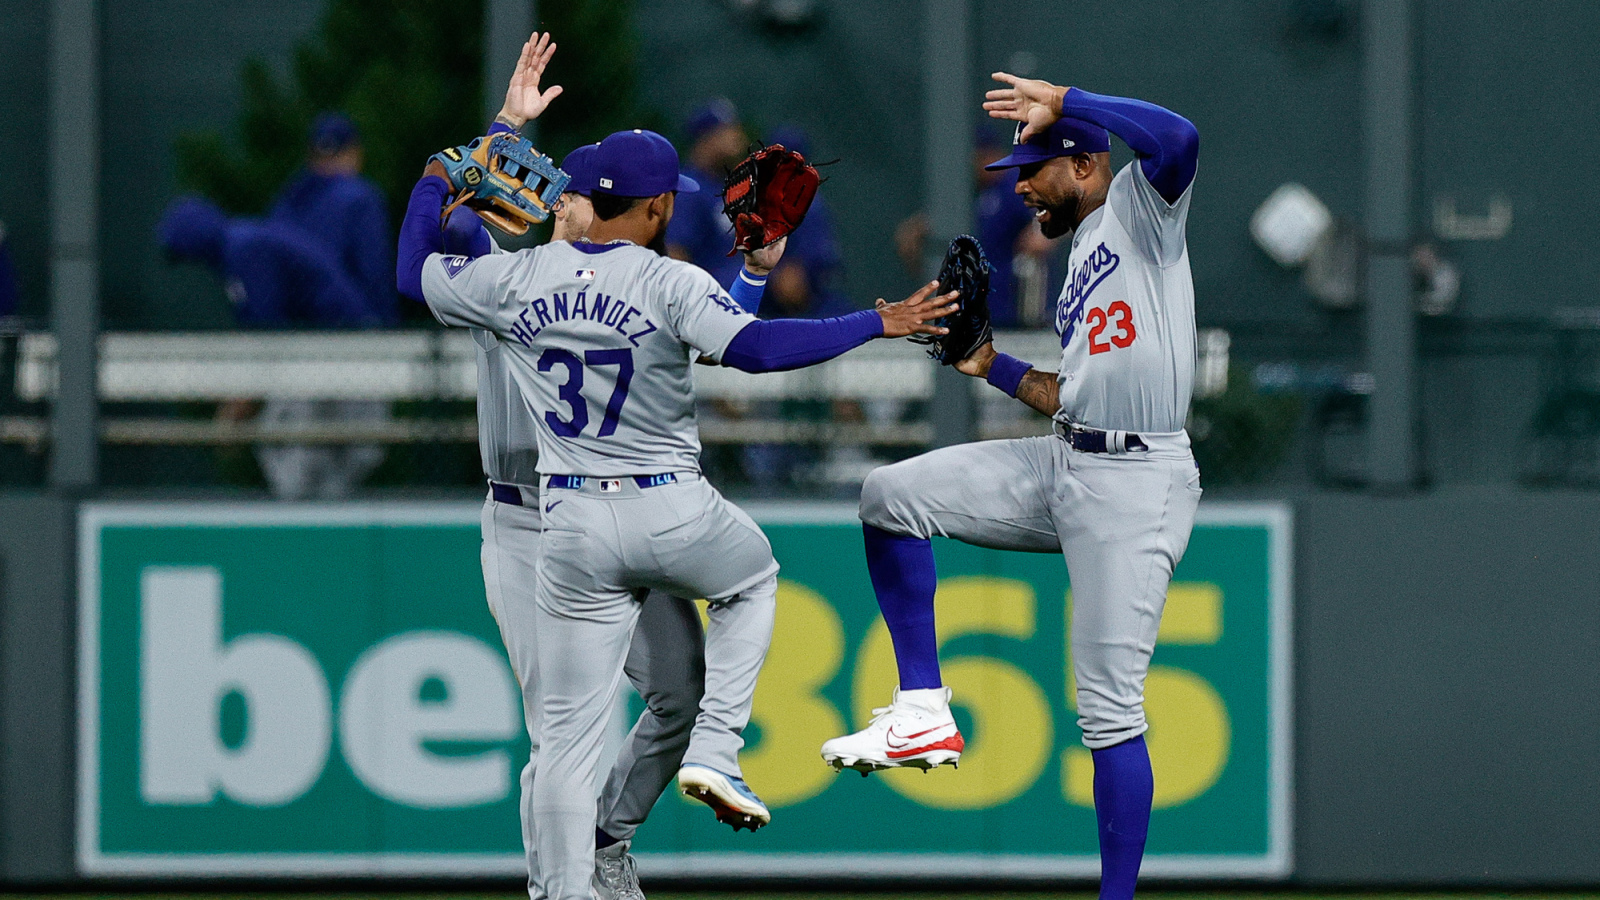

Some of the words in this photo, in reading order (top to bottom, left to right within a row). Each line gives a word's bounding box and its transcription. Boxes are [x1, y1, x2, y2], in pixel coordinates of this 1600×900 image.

[510, 284, 658, 349] HERNÁNDEZ
[1055, 242, 1120, 348] odgers
[1086, 300, 1136, 355] 23
[537, 348, 635, 438] 37
